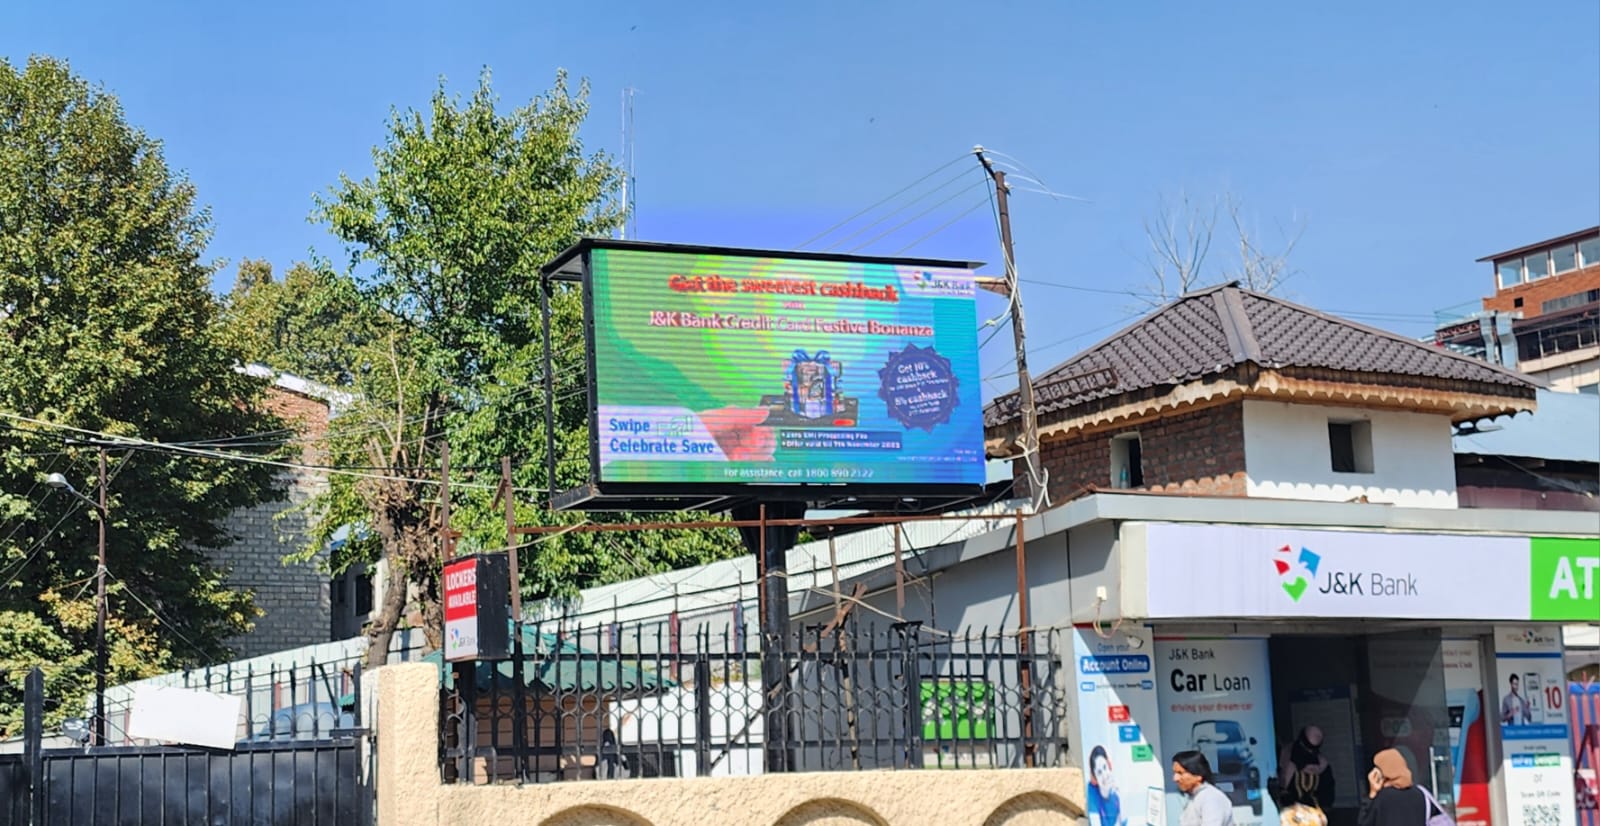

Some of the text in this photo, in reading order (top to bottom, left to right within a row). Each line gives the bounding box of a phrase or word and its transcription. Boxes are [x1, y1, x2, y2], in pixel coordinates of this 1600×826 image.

[668, 274, 899, 303] Get the sweetest cashback
[648, 310, 933, 337] J&K Bank Credit Card Festive Bonanza
[898, 364, 913, 374] Get
[896, 370, 938, 384] cashback
[908, 389, 948, 404] cashback
[609, 418, 650, 434] Swipe
[610, 438, 714, 453] Celebrate Save
[724, 468, 738, 477] For
[739, 468, 783, 478] assistance
[787, 468, 802, 477] call
[805, 468, 829, 478] 1800
[850, 469, 874, 478] 2122
[447, 568, 476, 590] LOCKERS
[1319, 571, 1418, 596] J&K Bank
[449, 590, 476, 608] AVAILABLE
[1168, 648, 1215, 660] J&K Bank
[1083, 657, 1148, 672] Account Online
[1170, 668, 1207, 693] Car
[1213, 673, 1251, 691] Loan
[1544, 685, 1562, 710] 10
[1170, 703, 1196, 713] driving
[1198, 704, 1214, 713] your
